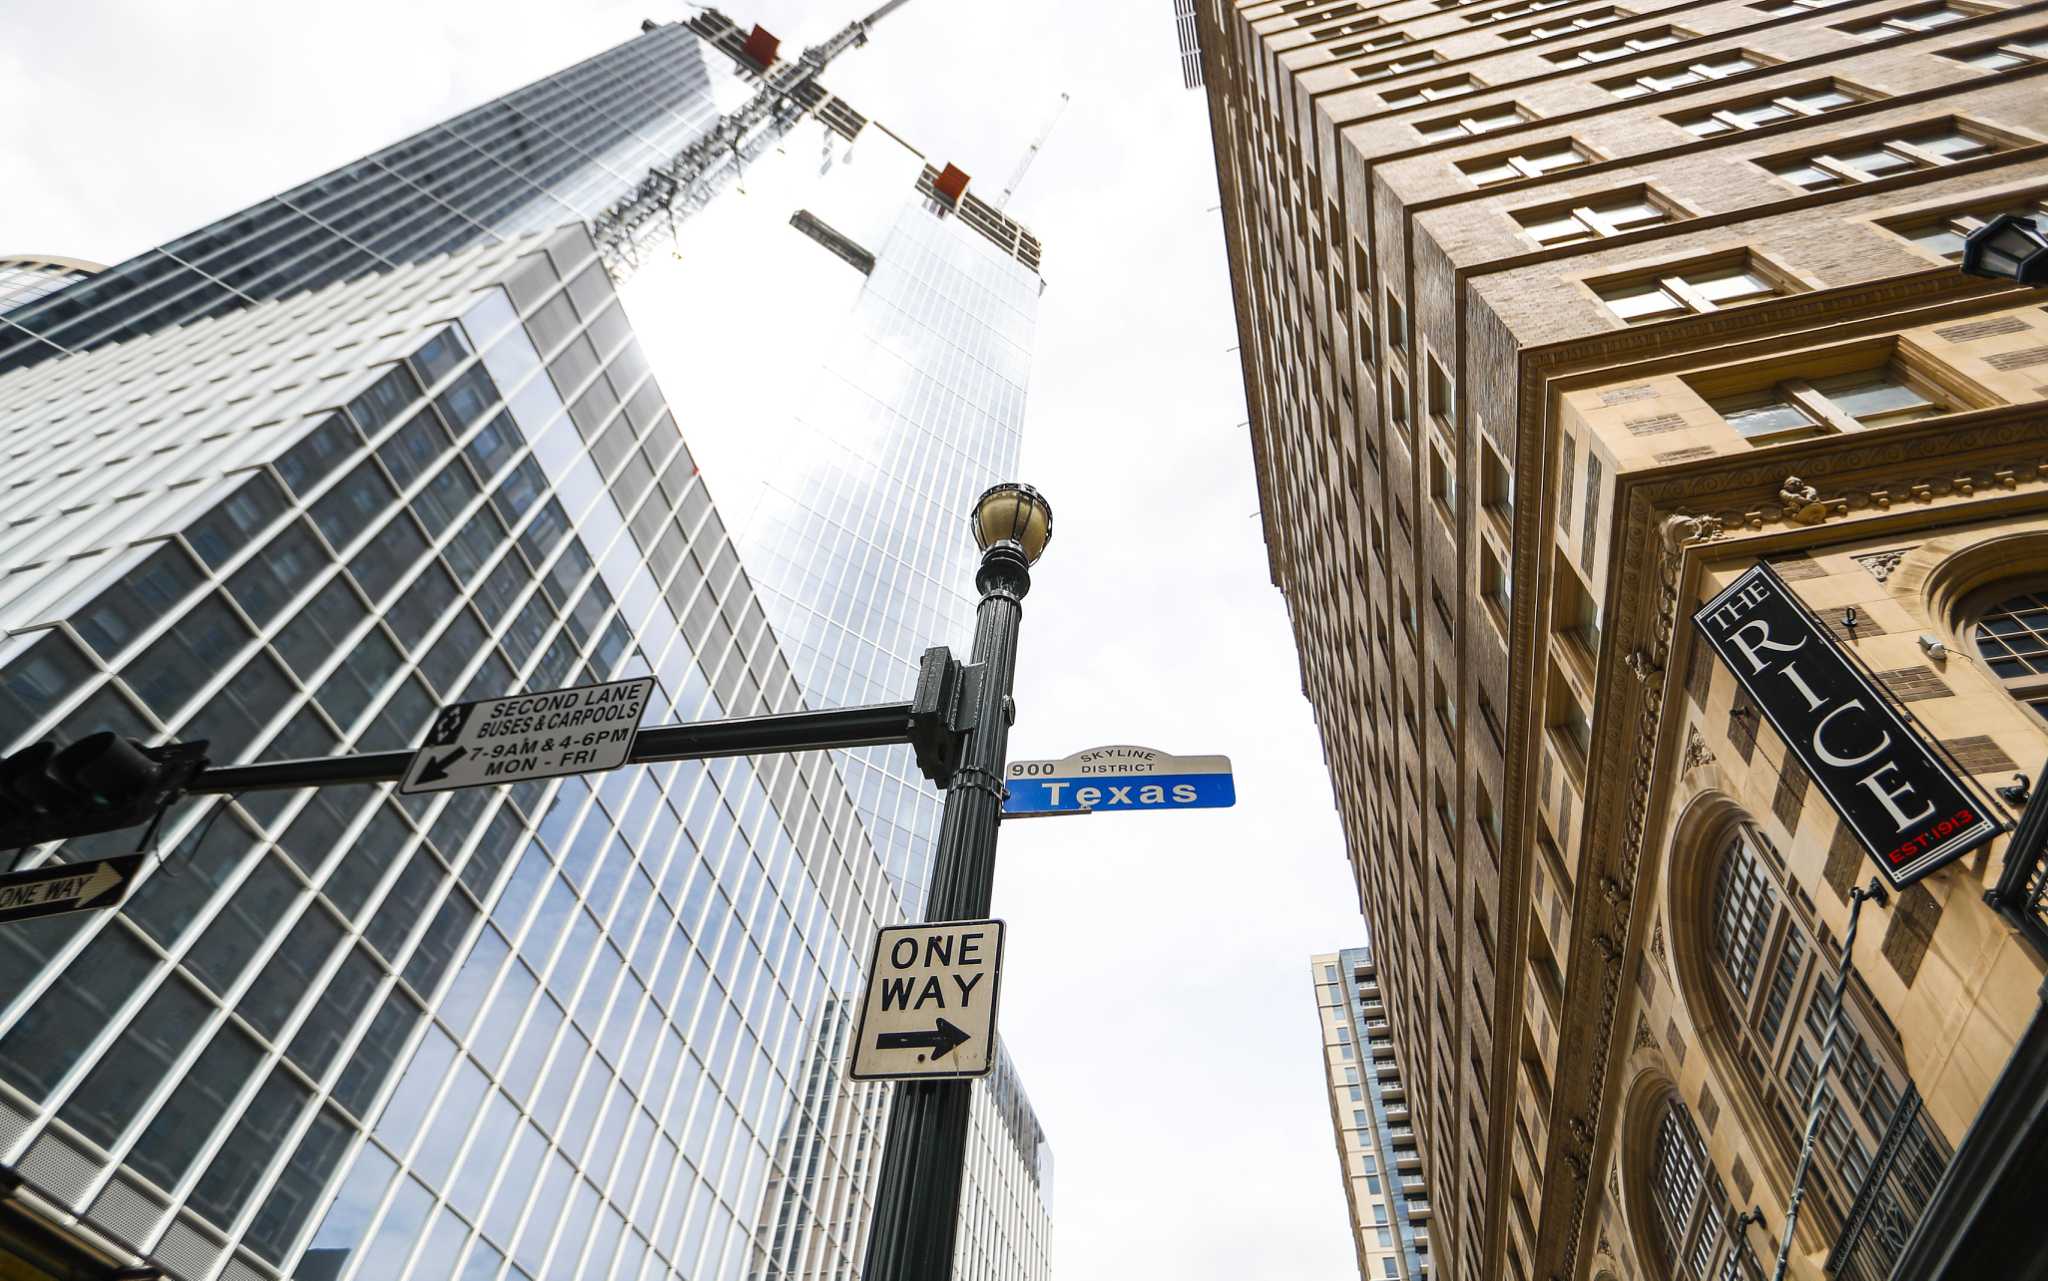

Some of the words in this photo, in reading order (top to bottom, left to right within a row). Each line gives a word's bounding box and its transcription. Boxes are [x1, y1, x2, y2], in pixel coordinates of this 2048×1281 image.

[1707, 581, 1770, 632] THE
[490, 693, 580, 719] SECOND
[585, 683, 643, 706] LANE
[477, 716, 533, 739] BUSES
[547, 701, 641, 729] CARPOOLS
[1725, 619, 1936, 834] RICE
[469, 739, 537, 762] 7-9AM
[541, 737, 554, 752] &
[558, 727, 631, 750] 4-6PM
[1080, 749, 1157, 763] SKYLINE
[484, 757, 538, 777] MON
[558, 749, 598, 767] FRI
[1011, 763, 1056, 777] 900
[1081, 763, 1156, 774] DISTRICT
[1041, 782, 1199, 807] Texas
[0, 883, 43, 908] ONE
[44, 875, 95, 901] WAY
[891, 932, 984, 969] ONE
[881, 972, 985, 1012] WAY
